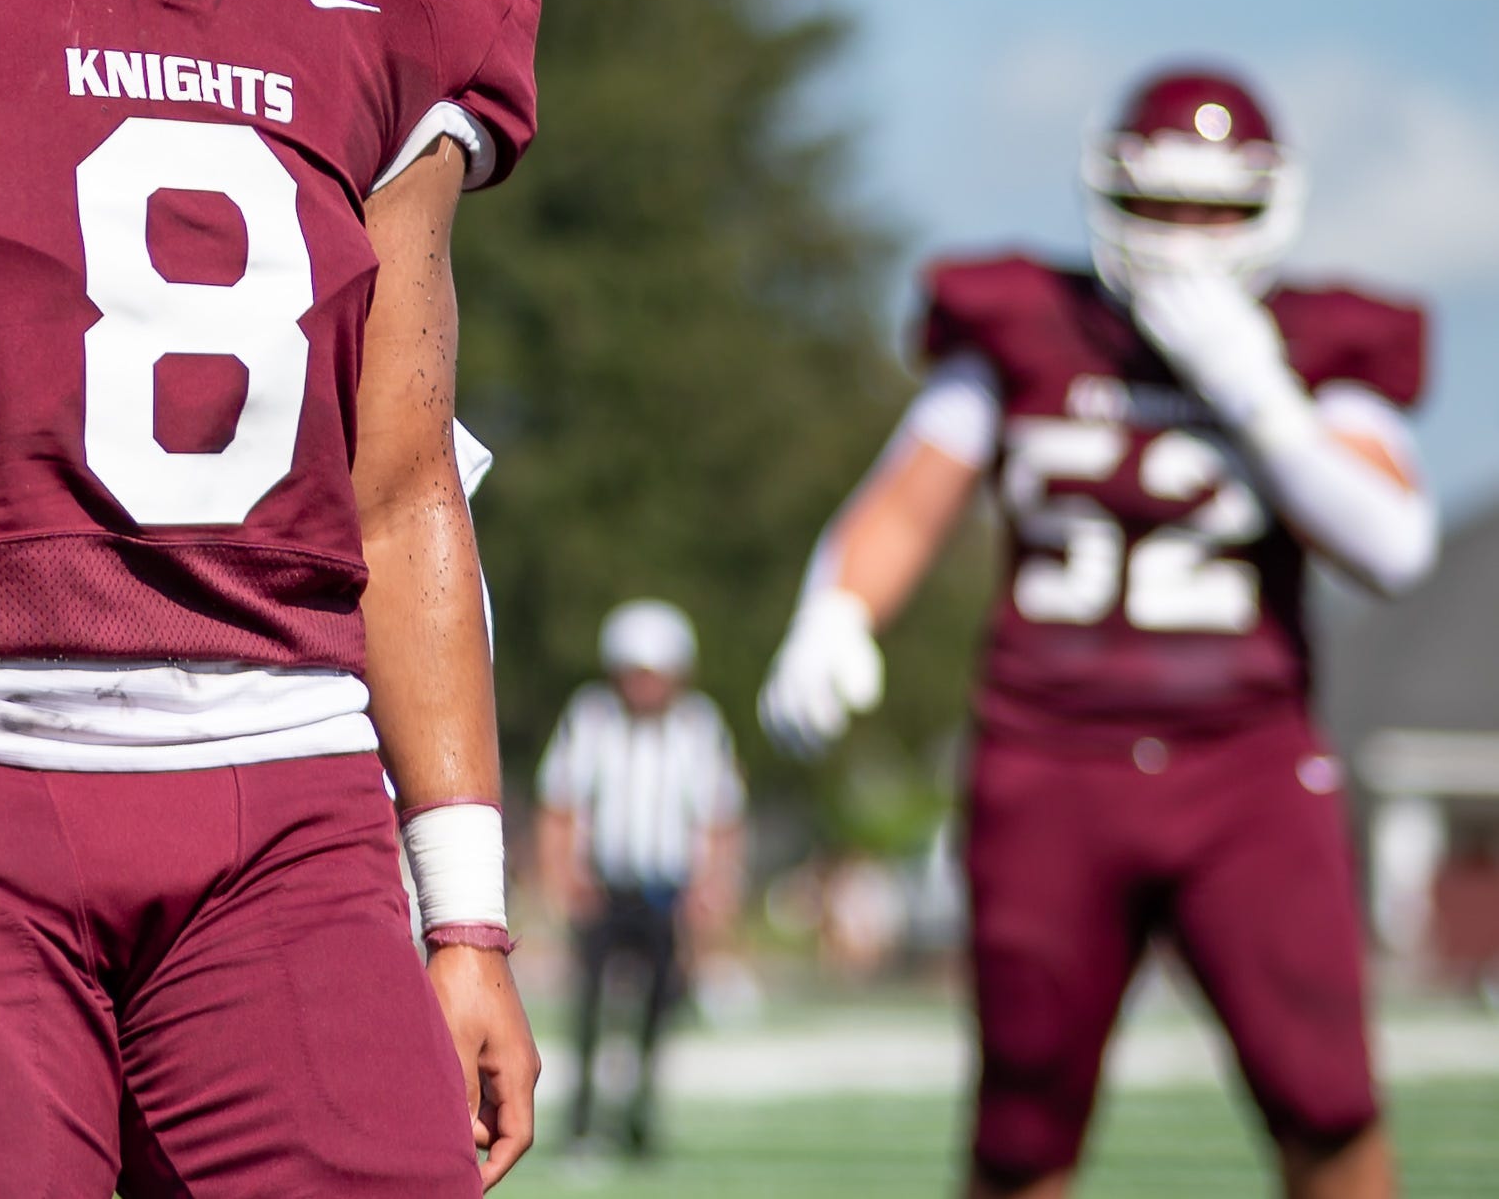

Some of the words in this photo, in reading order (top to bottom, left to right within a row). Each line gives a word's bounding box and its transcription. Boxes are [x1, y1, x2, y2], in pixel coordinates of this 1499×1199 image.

[65, 48, 294, 123] KNIGHTS
[75, 116, 314, 525] 8
[1004, 414, 1263, 635] 52
